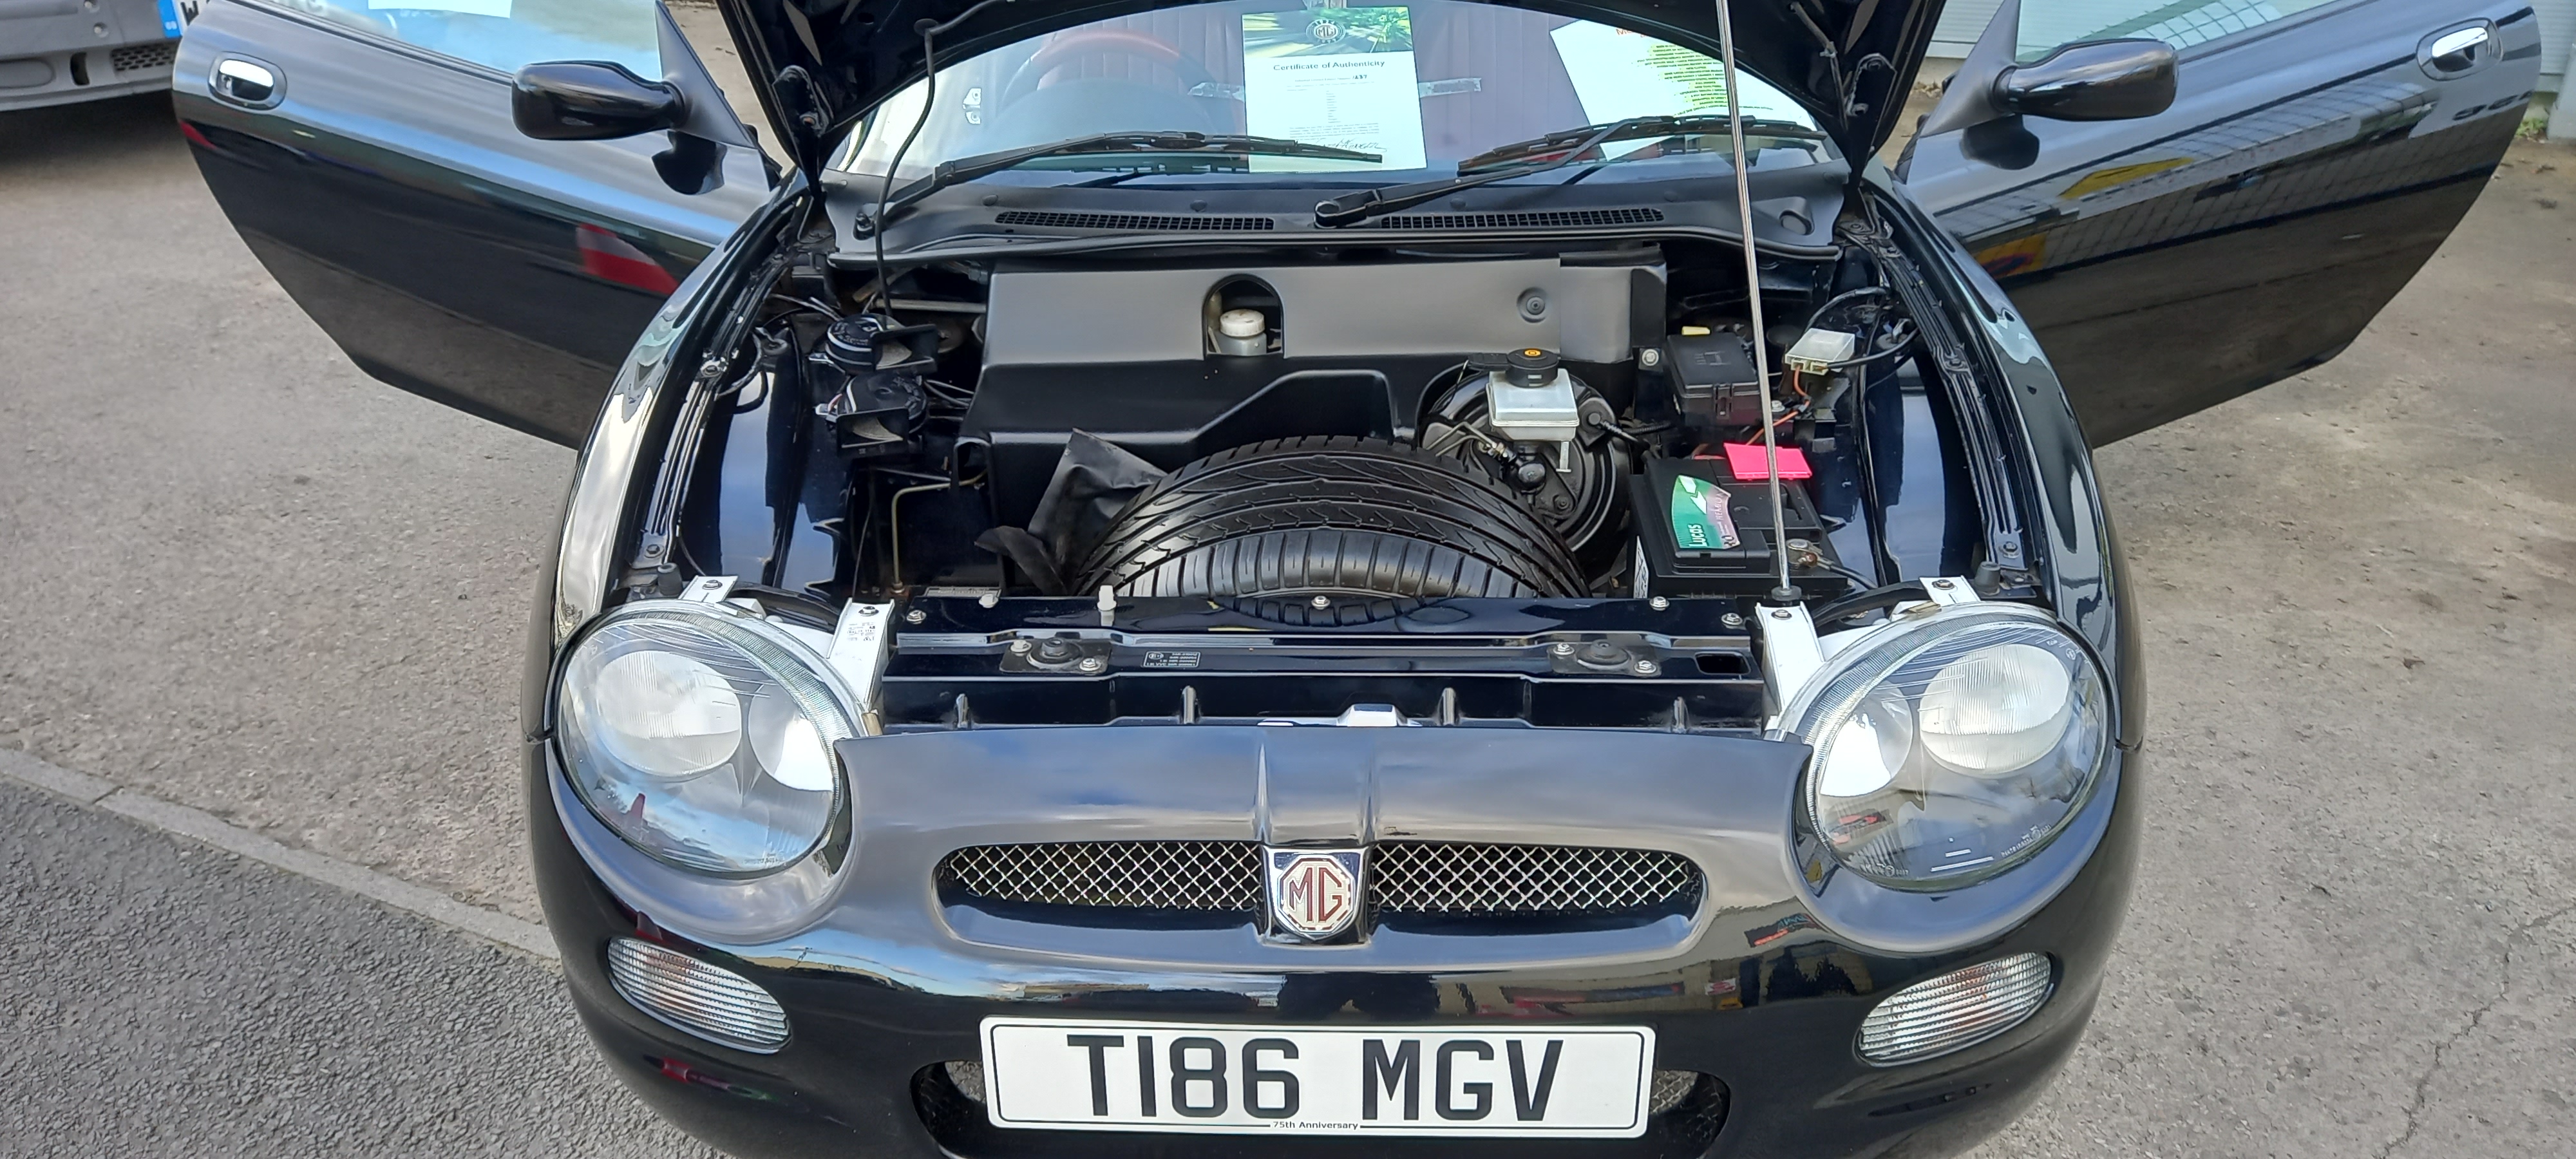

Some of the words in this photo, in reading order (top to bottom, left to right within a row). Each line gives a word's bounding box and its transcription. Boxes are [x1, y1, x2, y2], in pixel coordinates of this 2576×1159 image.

[1332, 60, 1385, 68] Authenticity
[1687, 523, 1708, 548] Lucas
[1289, 866, 1343, 923] MG
[1066, 1033, 1300, 1118] T186
[1361, 1038, 1564, 1121] MGV
[1273, 1120, 1295, 1129] 75th
[1298, 1121, 1358, 1130] Anniversary
